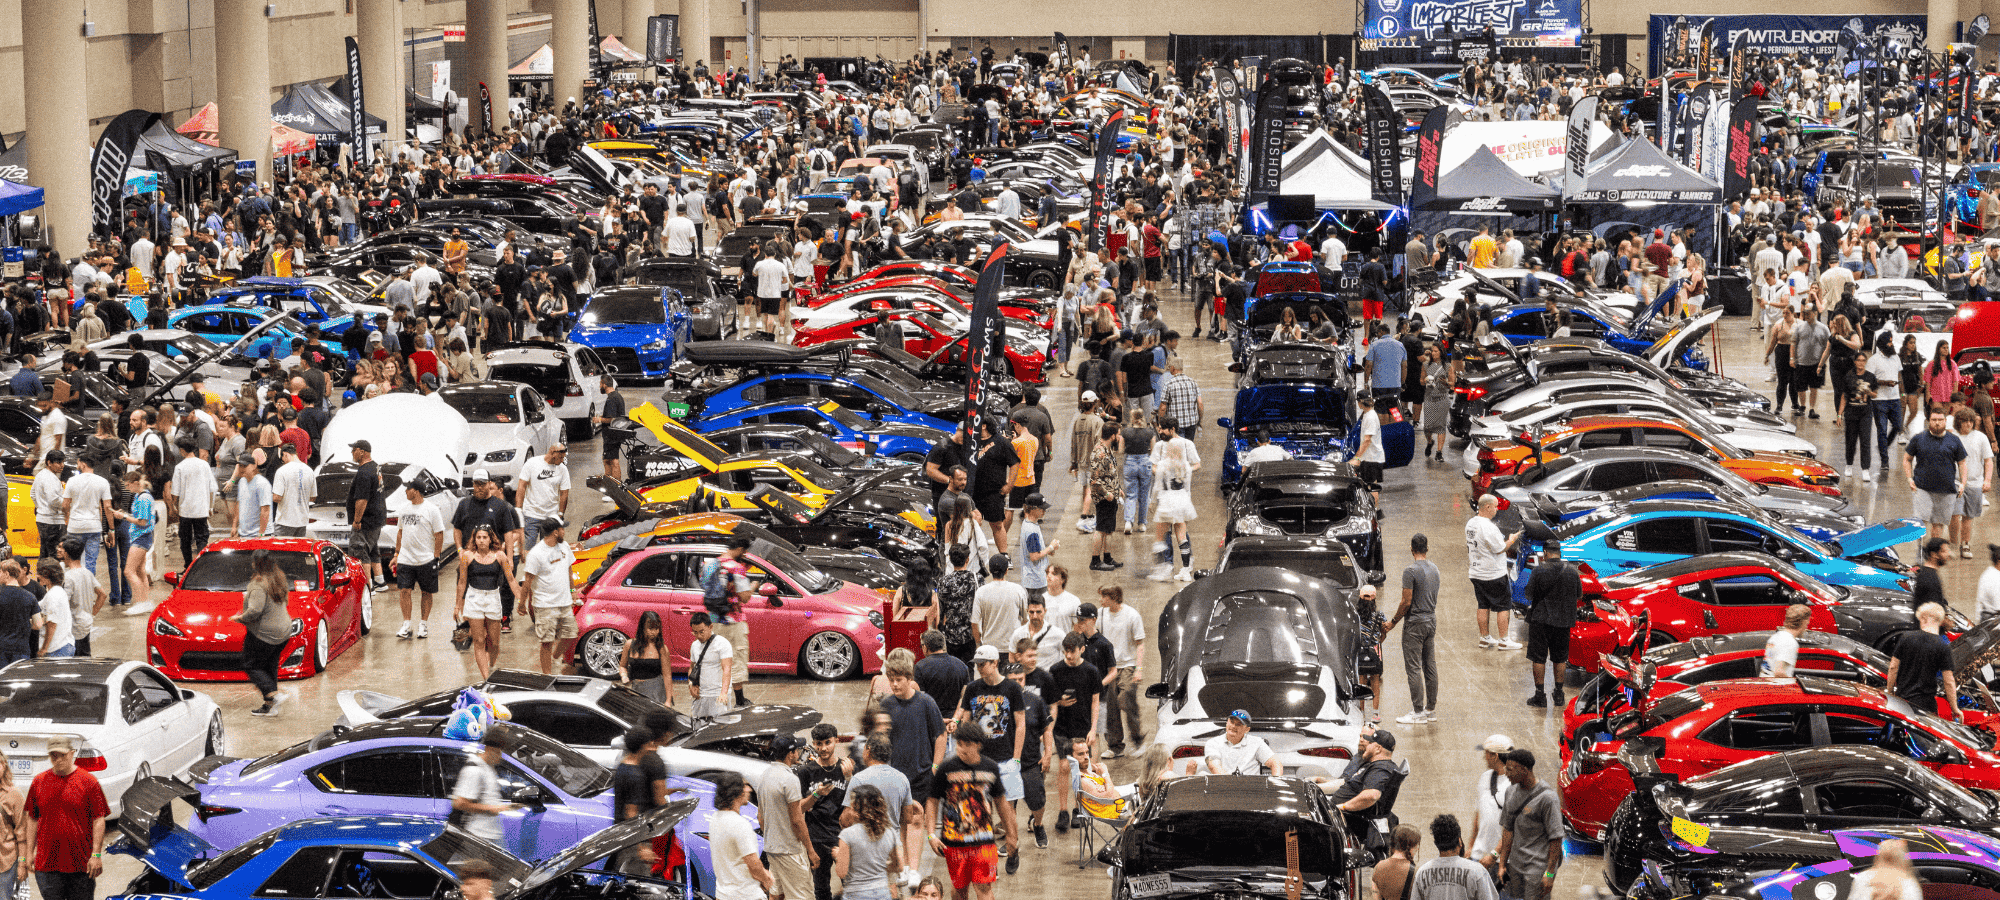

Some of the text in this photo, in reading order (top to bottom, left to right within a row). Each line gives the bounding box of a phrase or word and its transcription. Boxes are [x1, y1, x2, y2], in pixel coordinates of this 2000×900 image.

[1521, 23, 1542, 31] GR
[1816, 46, 1837, 54] LIFEST
[315, 133, 339, 142] ICATE
[1508, 136, 1566, 153] ORIGINA
[1267, 119, 1282, 187] GLOSHOP
[1378, 119, 1393, 187] GLOSHOP
[1620, 190, 1673, 201] DRIFTCVLTURE
[1680, 190, 1715, 201] BANNERS
[969, 316, 995, 466] AUTO CUSTOMS
